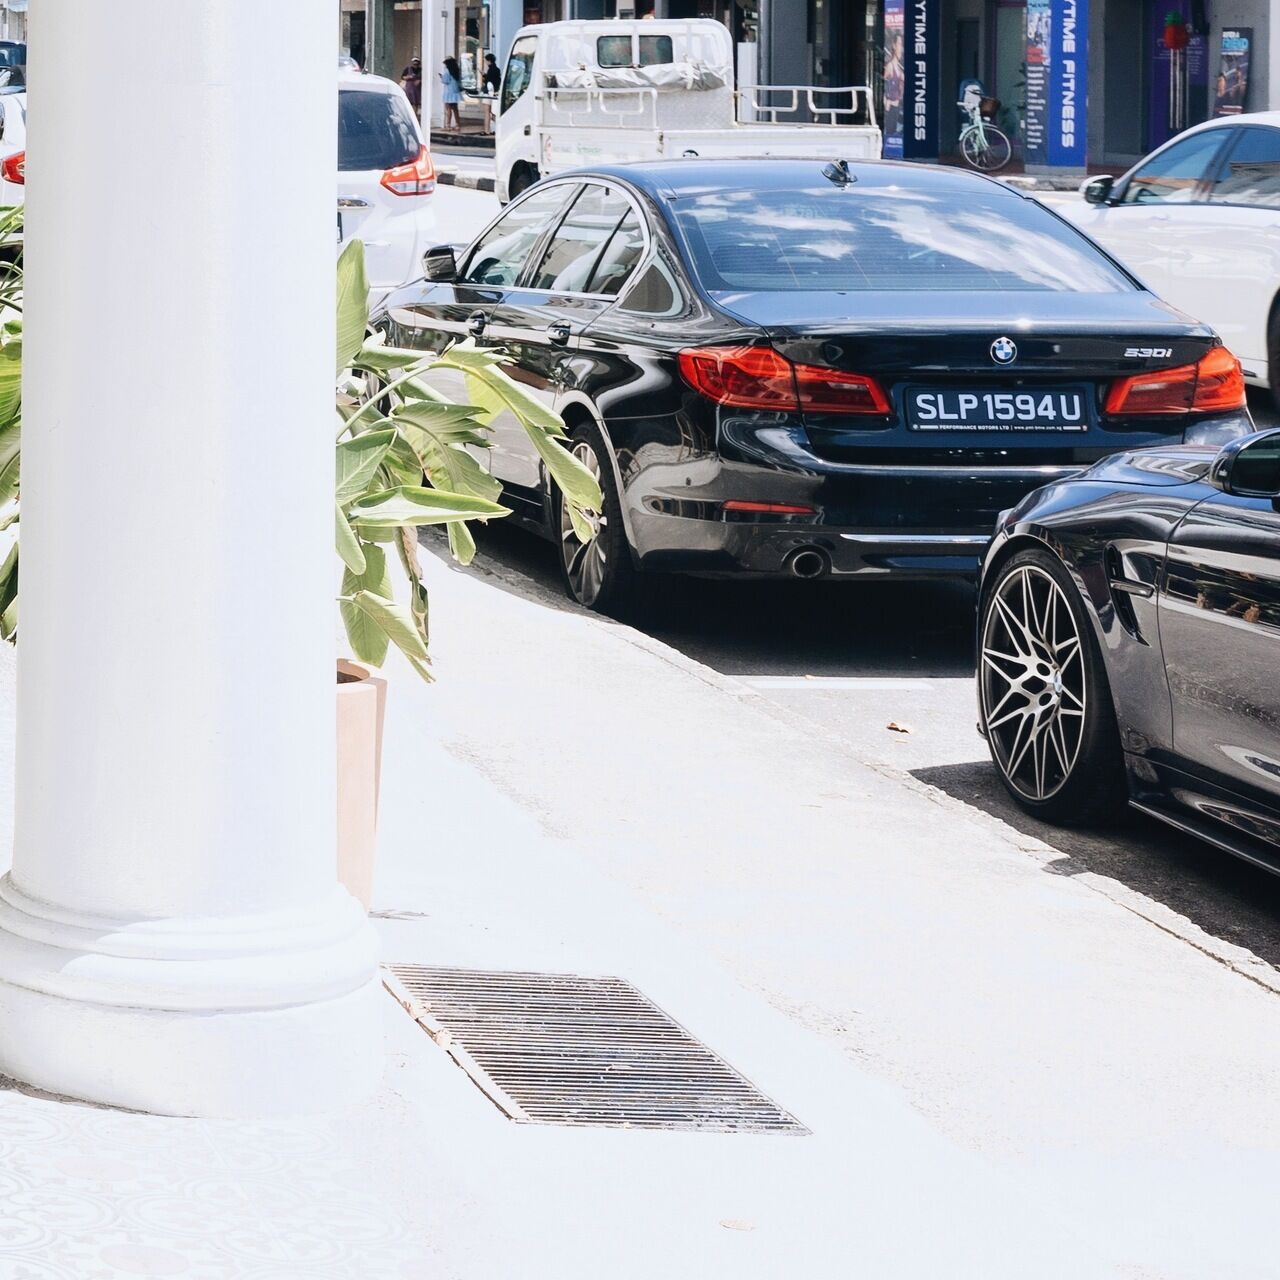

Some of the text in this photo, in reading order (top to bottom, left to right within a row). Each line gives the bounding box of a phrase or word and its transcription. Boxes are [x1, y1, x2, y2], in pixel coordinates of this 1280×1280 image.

[914, 60, 926, 141] FITNESS
[1061, 59, 1076, 148] FITNESS
[1123, 347, 1173, 358] 530i
